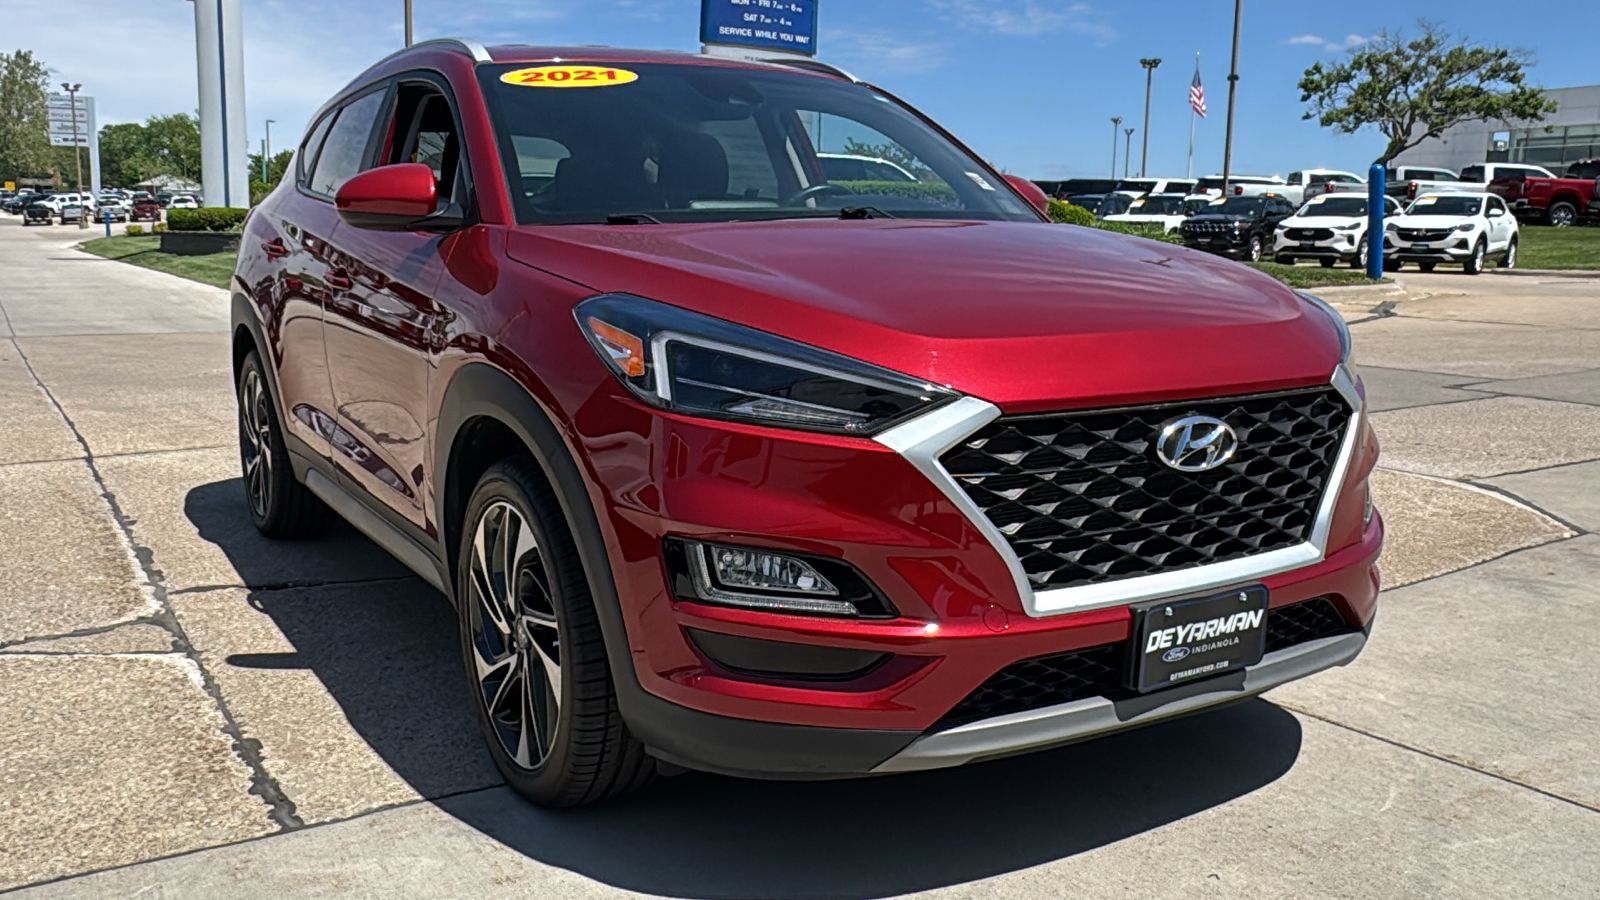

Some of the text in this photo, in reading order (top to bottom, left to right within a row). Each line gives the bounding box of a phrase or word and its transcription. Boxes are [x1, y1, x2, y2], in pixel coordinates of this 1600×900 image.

[743, 13, 758, 22] SAT
[719, 26, 810, 44] SERVICE WHILE YOU WAIT
[520, 70, 617, 83] 2021
[1145, 609, 1264, 654] DEYARMAN
[1192, 637, 1240, 654] INDIANOLA
